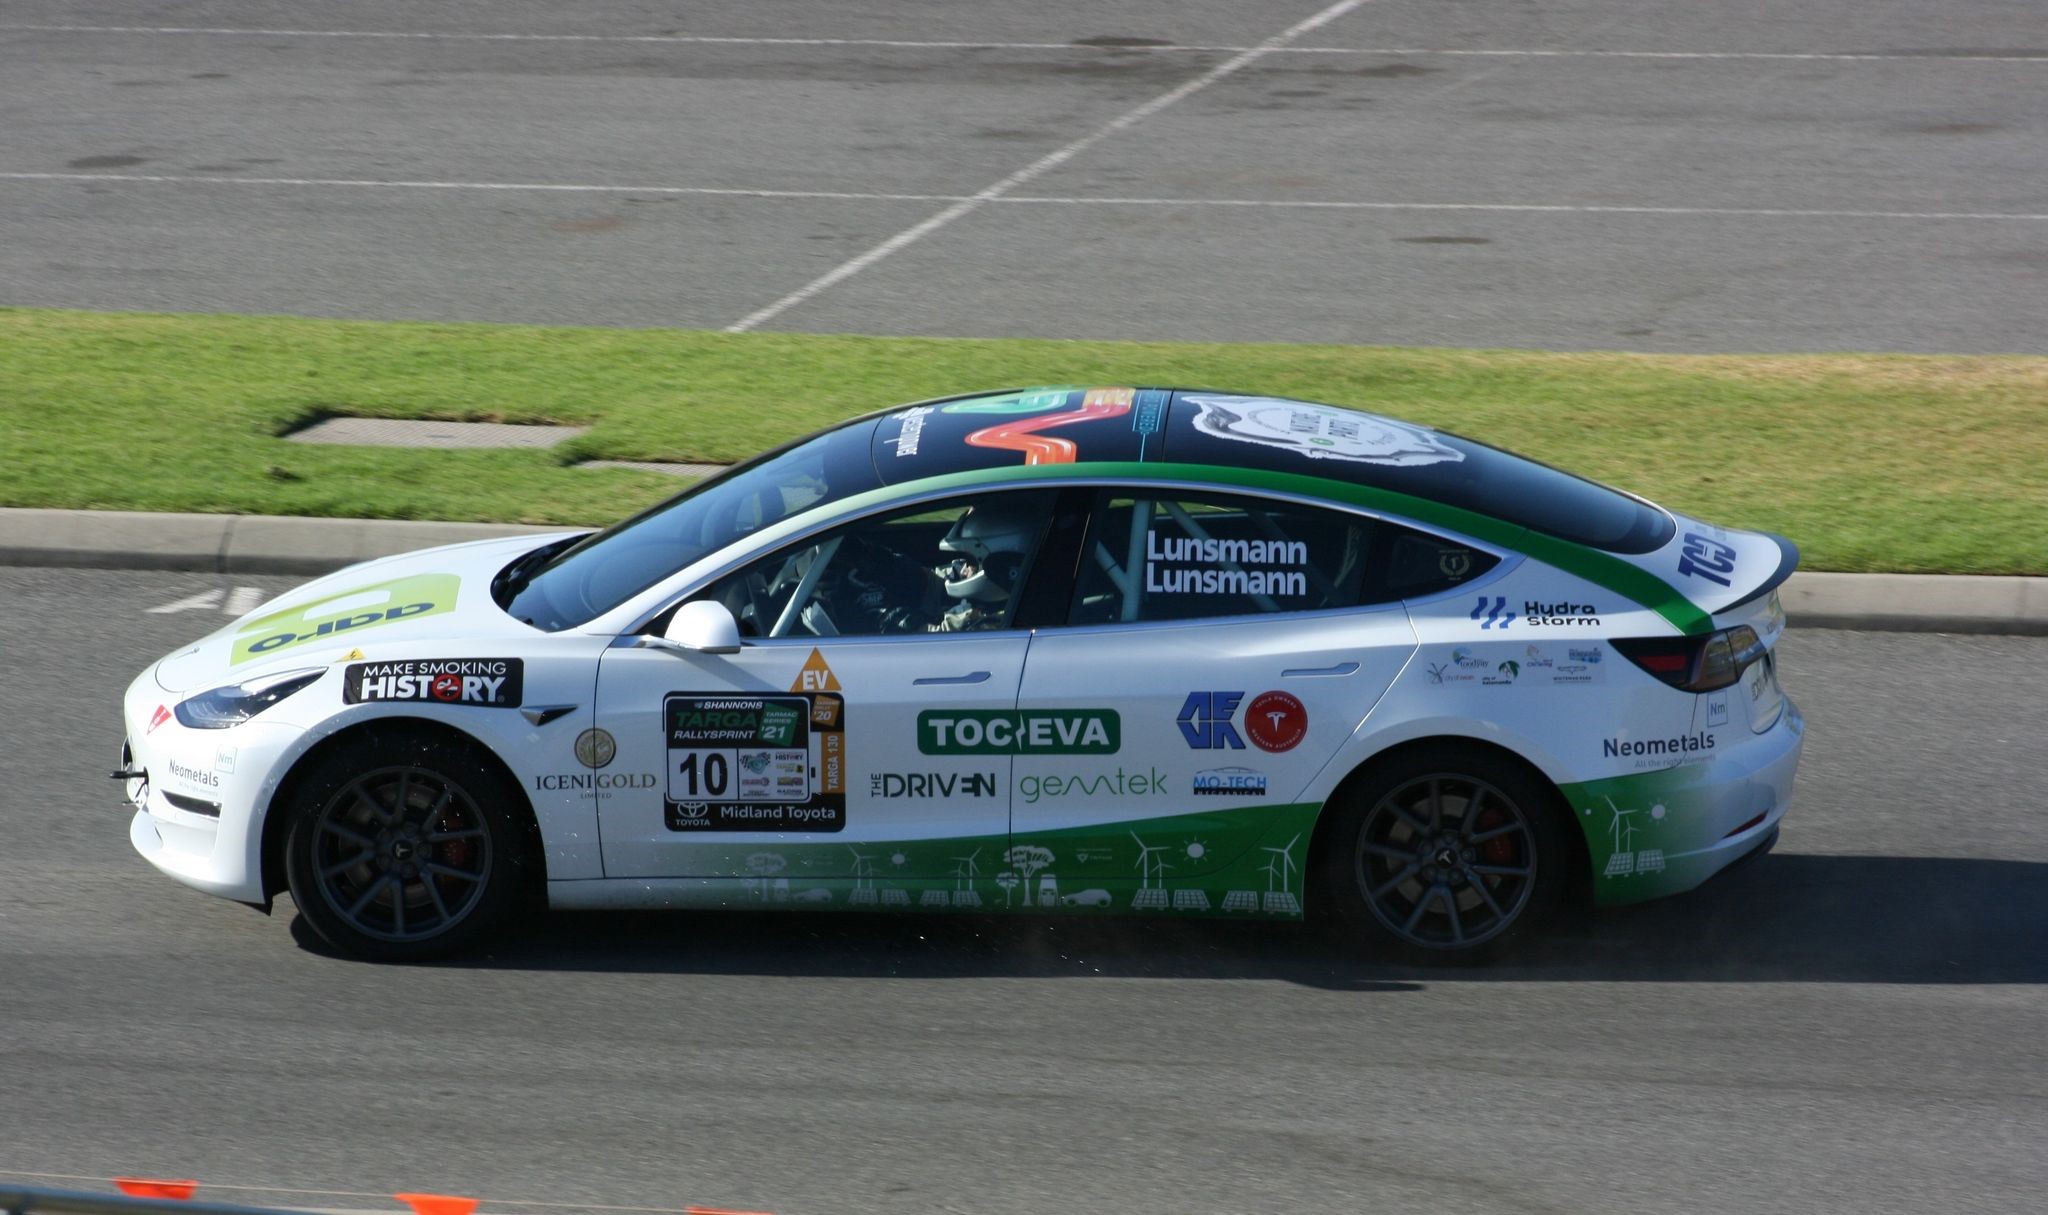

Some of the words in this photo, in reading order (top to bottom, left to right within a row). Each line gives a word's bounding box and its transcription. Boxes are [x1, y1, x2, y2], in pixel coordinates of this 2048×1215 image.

[1147, 530, 1307, 565] Lunsmann
[1146, 562, 1306, 596] Lunsmann
[1525, 601, 1596, 617] Hydra
[1527, 617, 1600, 626] Storm
[363, 662, 414, 677] MAKE
[419, 661, 506, 674] SMOKING
[361, 674, 506, 702] HISTORY
[802, 670, 829, 690] EV
[703, 701, 763, 710] SHANNONS
[1710, 702, 1726, 717] Nm
[675, 711, 758, 727] TARGA
[674, 730, 756, 740] RALLYSPRINT
[761, 727, 786, 739] '21
[827, 735, 839, 753] 130
[1603, 731, 1716, 757] Neometals
[169, 758, 219, 787] Neometals
[680, 752, 728, 797] 10
[827, 756, 839, 790] TARGA
[536, 775, 592, 790] ICENI
[597, 774, 656, 788] GOLD
[871, 773, 881, 798] THE
[883, 773, 995, 798] DRIVEN
[1193, 776, 1267, 788] MO-TECH
[720, 806, 783, 819] Midland
[787, 806, 836, 821] Toyota
